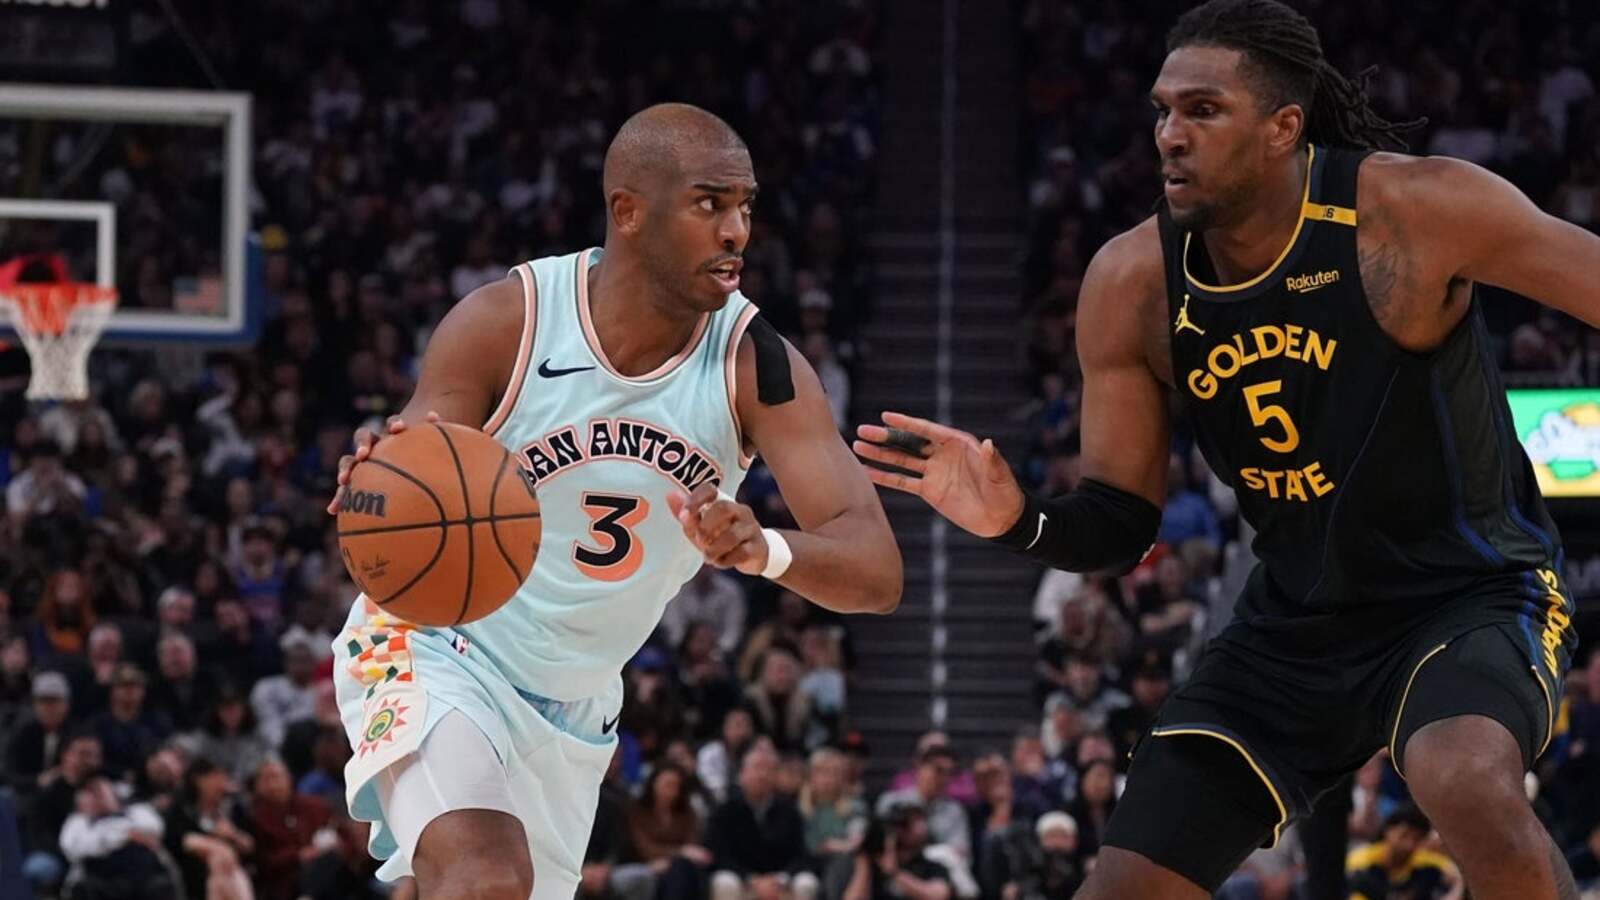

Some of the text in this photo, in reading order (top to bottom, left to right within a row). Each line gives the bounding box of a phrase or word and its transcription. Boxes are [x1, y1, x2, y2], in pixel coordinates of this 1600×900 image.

[1286, 269, 1340, 292] Rakuten
[1187, 323, 1338, 400] GOLDEN
[1242, 379, 1300, 453] 5
[1239, 461, 1336, 502] STATE
[572, 492, 649, 581] 3
